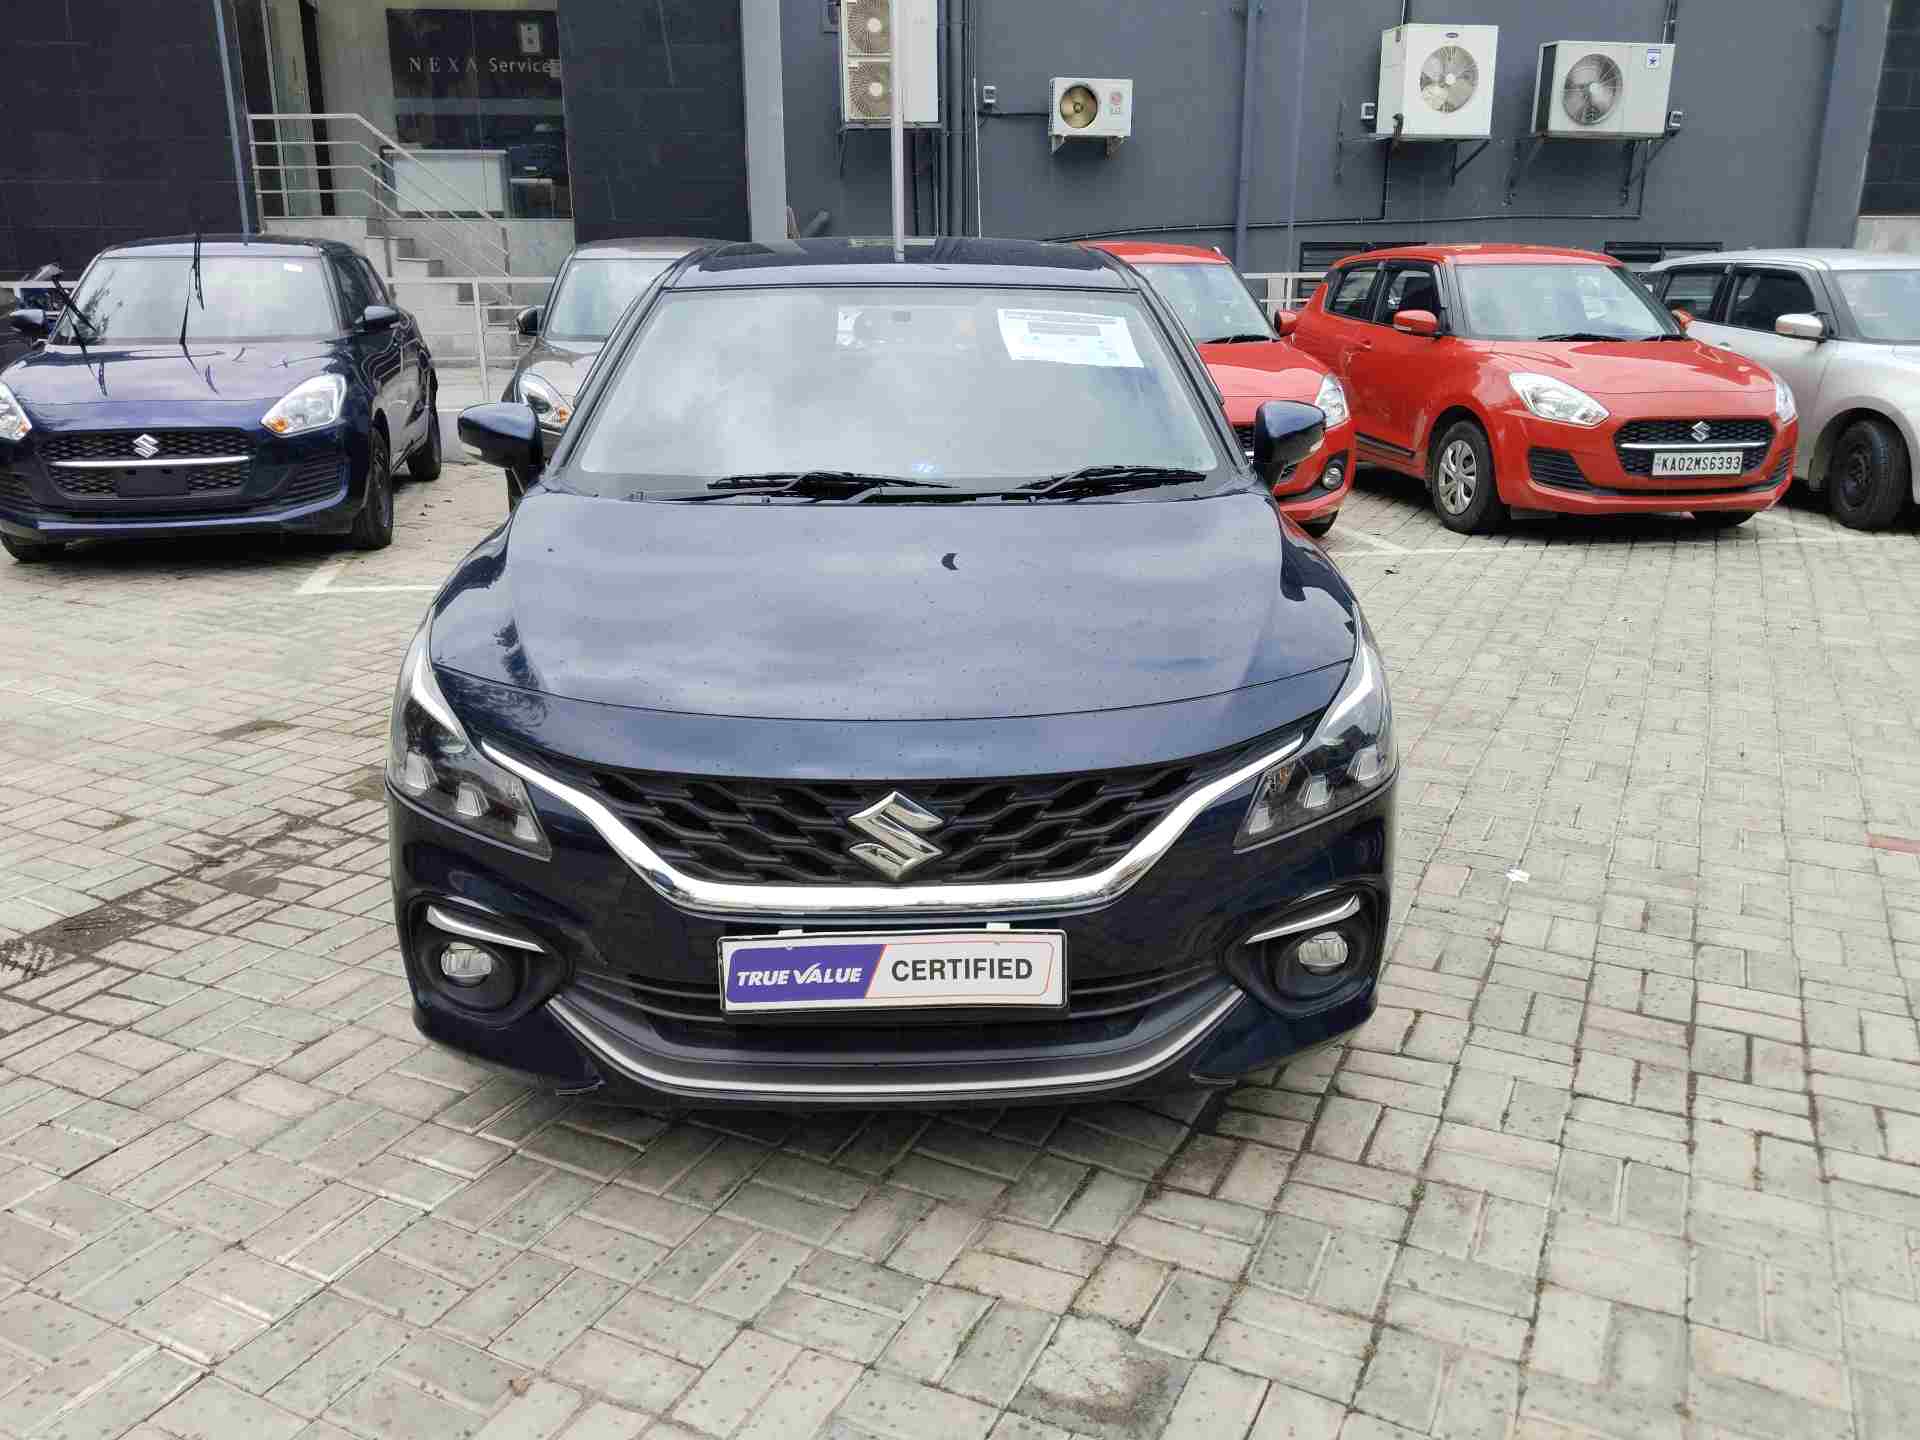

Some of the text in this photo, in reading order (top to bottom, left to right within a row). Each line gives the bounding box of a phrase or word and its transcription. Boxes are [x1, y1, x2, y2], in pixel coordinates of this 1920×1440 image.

[408, 56, 552, 73] NEXA Service
[736, 957, 1033, 986] TRUE VALUE CERTIFIED
